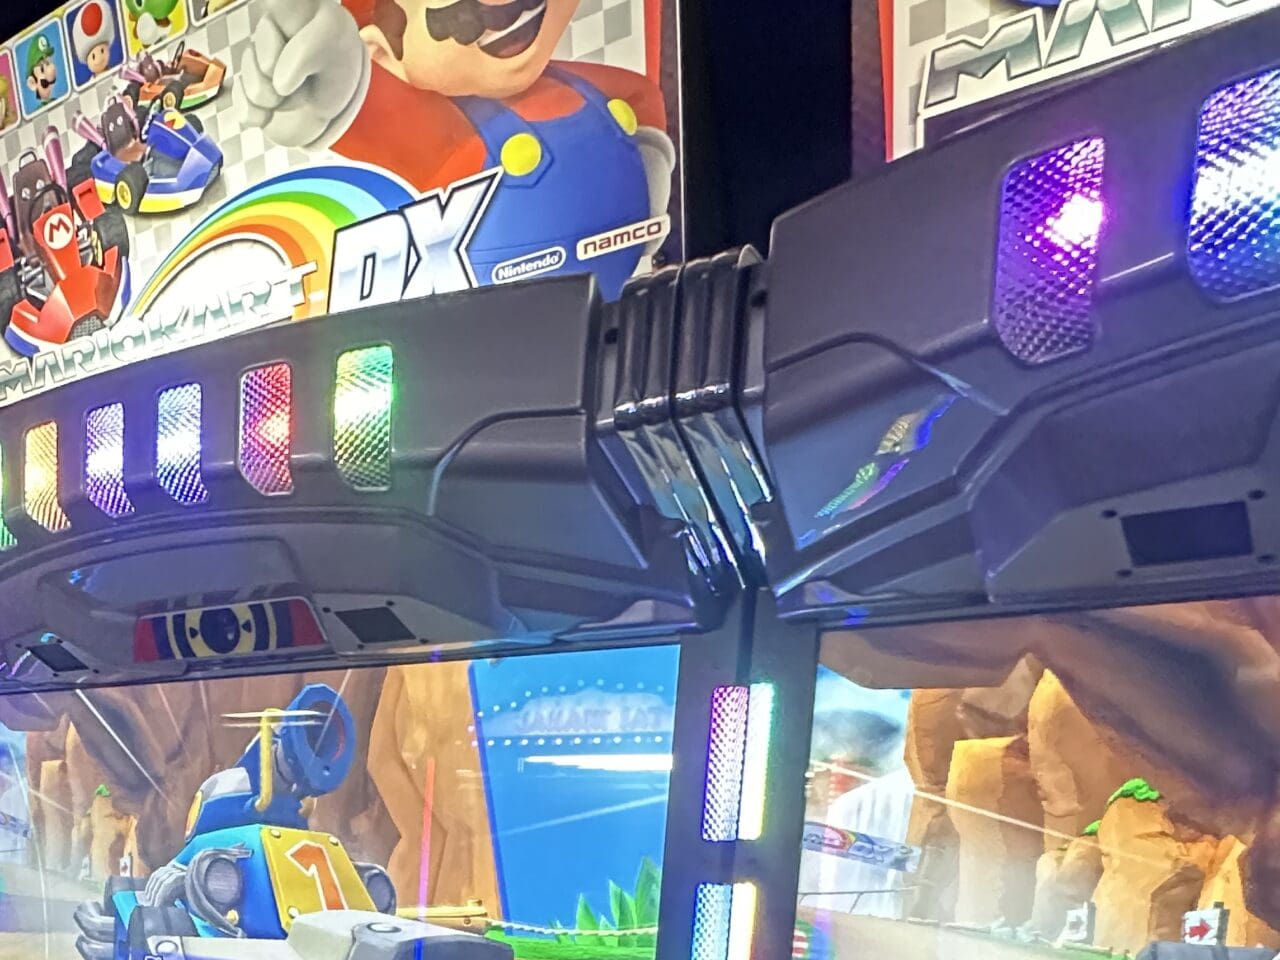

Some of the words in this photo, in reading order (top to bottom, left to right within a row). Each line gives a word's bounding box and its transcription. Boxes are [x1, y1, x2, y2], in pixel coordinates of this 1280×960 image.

[327, 170, 500, 312] DX
[583, 221, 662, 255] namco
[497, 252, 560, 280] Nintendo
